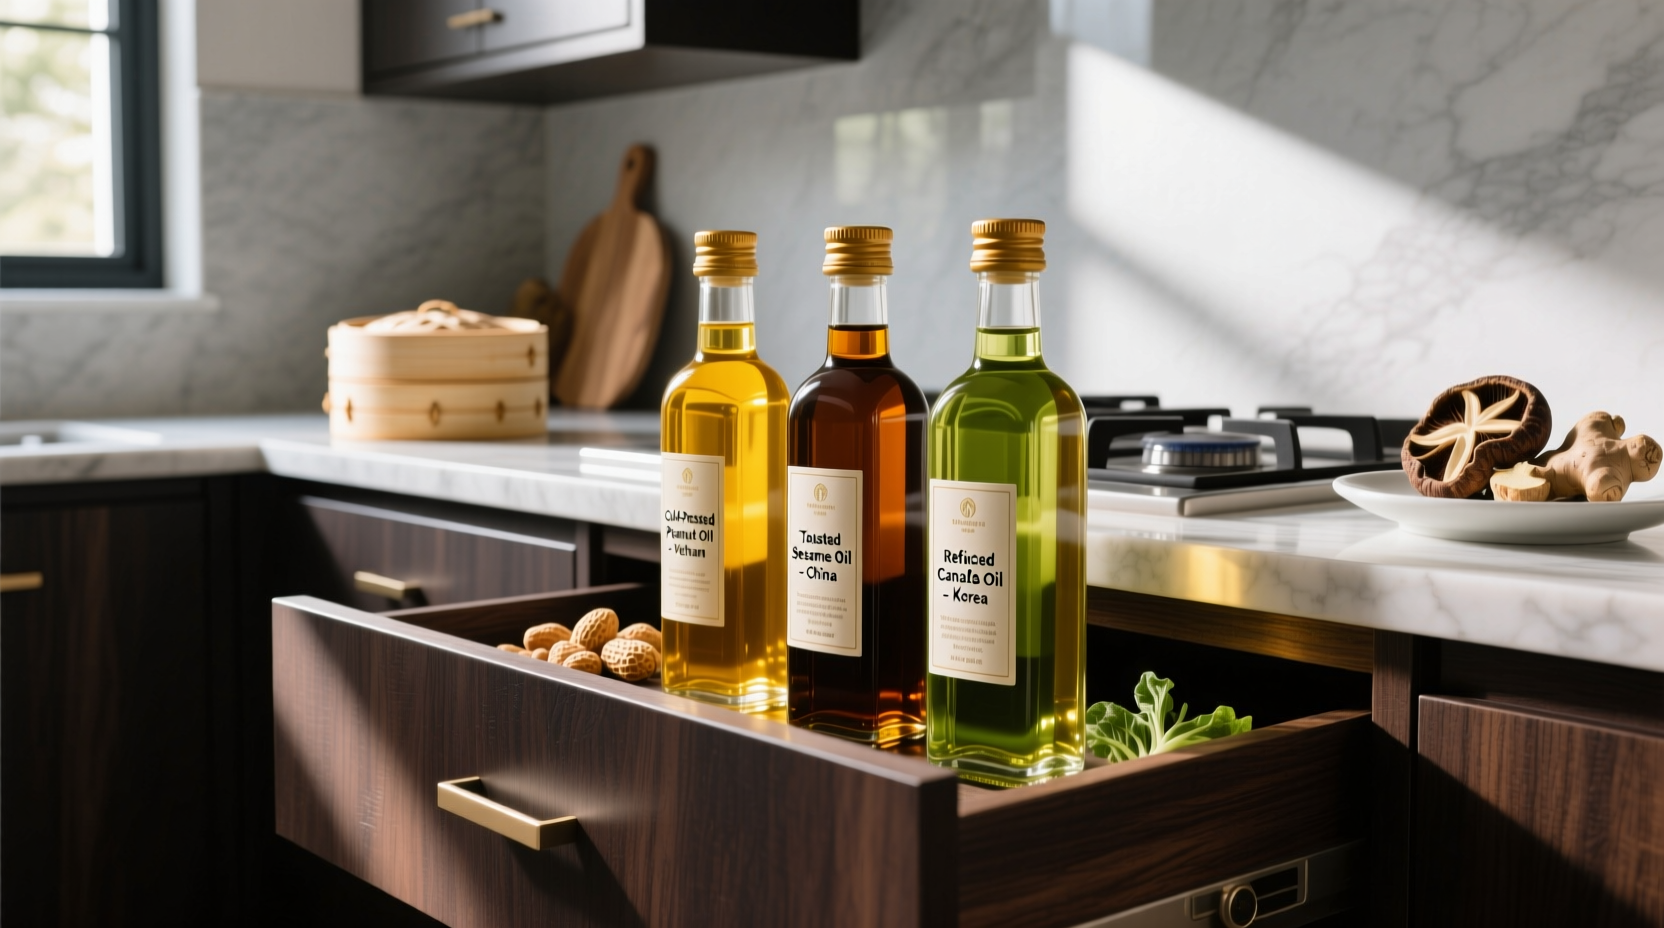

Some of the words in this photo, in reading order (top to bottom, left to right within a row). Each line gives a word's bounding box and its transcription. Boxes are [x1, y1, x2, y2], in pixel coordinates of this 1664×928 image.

[834, 550, 852, 565] Oil
[806, 565, 838, 582] China
[983, 571, 1004, 587] Oil
[953, 586, 988, 606] Korea
